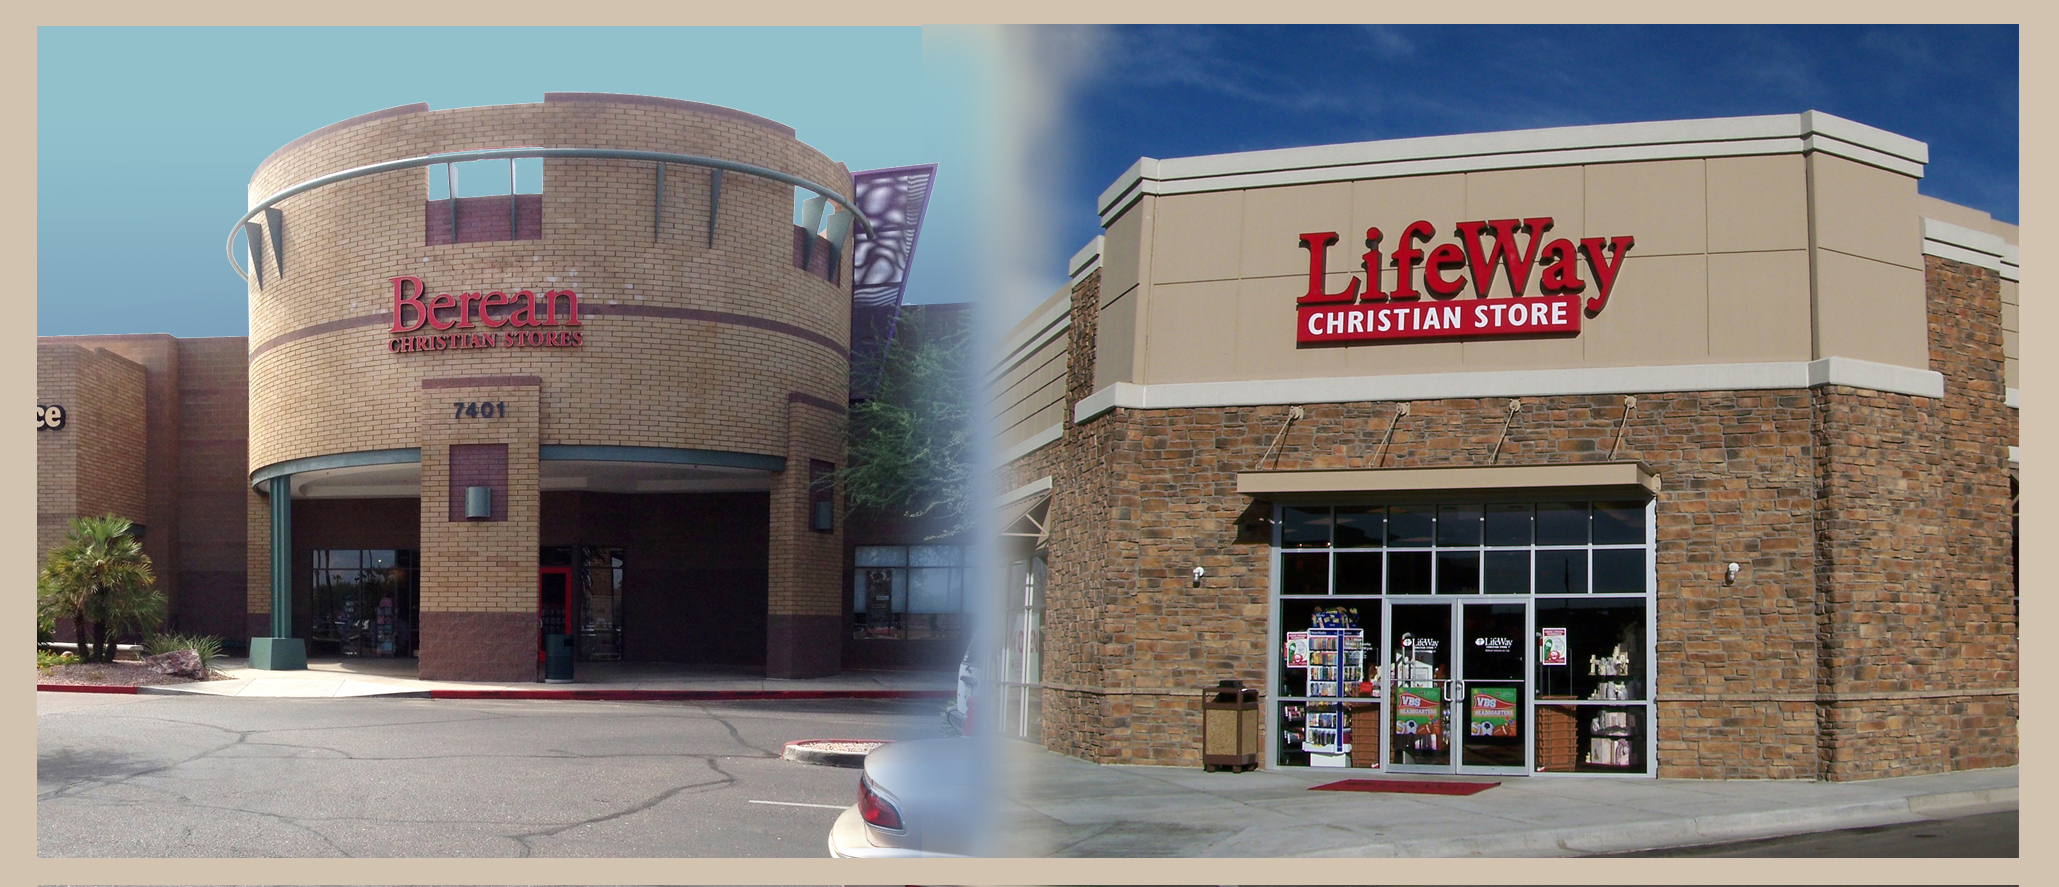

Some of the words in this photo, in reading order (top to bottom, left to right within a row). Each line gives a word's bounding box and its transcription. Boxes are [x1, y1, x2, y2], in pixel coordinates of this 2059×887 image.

[1297, 217, 1635, 318] LifeWay
[388, 276, 583, 333] Berean
[1308, 306, 1461, 336] CHRISTIAN
[1474, 301, 1568, 328] STORE
[388, 332, 498, 354] CHRISTIAN
[503, 330, 584, 348] STORES
[453, 401, 505, 419] 7401
[1401, 695, 1421, 707] VBS
[1476, 696, 1497, 708] VBS
